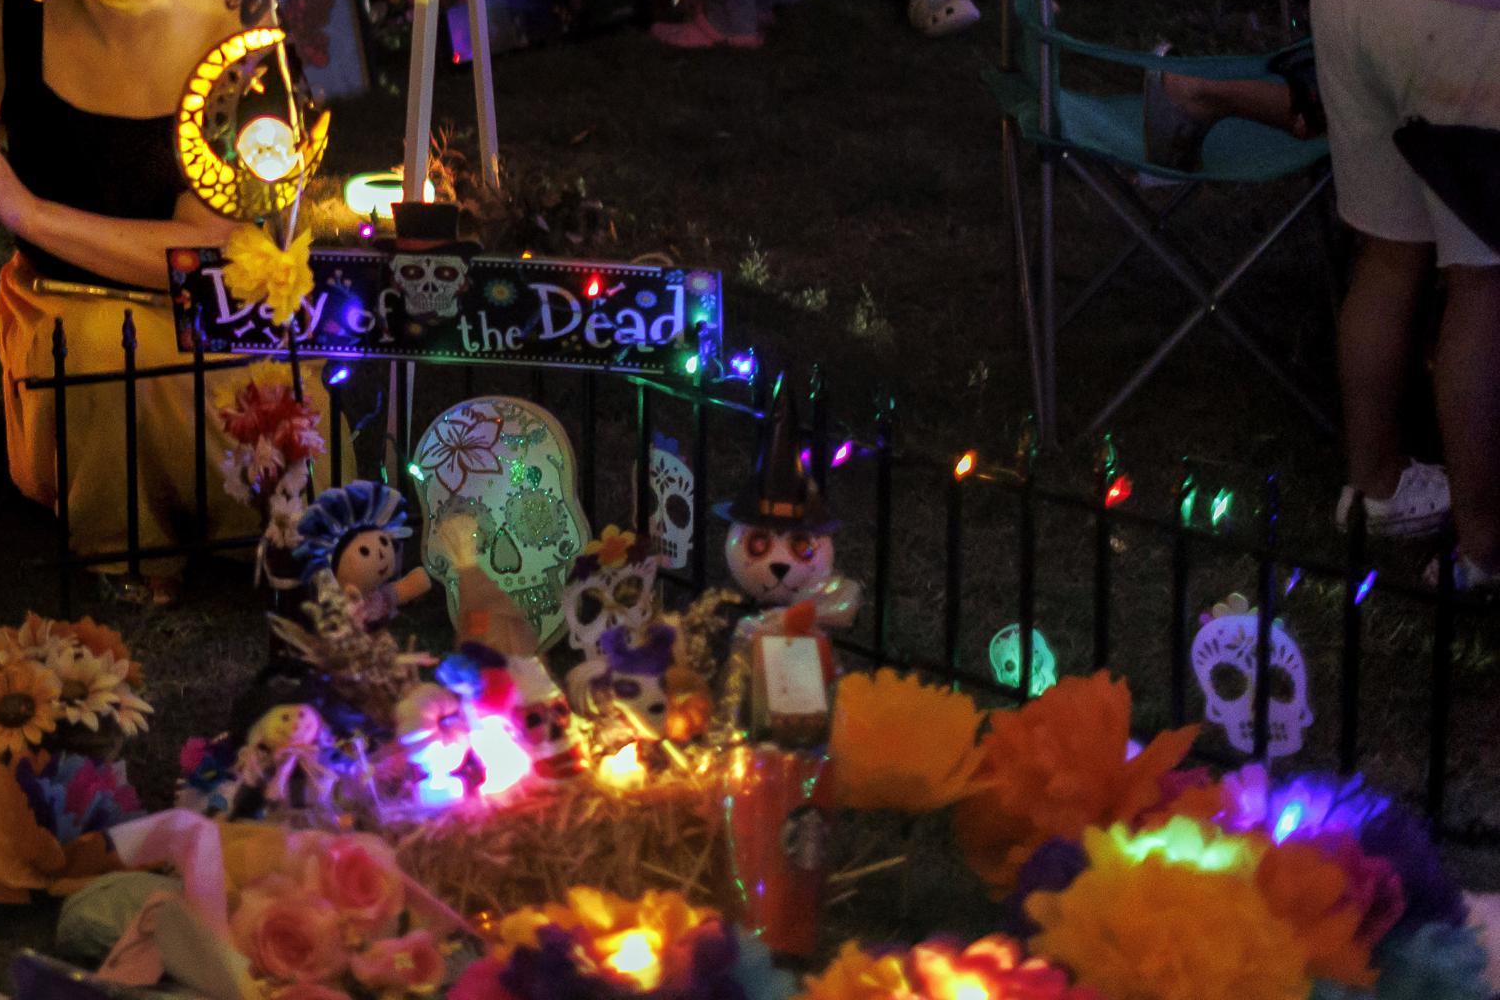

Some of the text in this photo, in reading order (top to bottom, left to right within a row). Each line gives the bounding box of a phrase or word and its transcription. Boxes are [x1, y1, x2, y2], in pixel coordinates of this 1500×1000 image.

[346, 288, 402, 343] of
[456, 310, 525, 353] the
[526, 281, 686, 354] Dead
